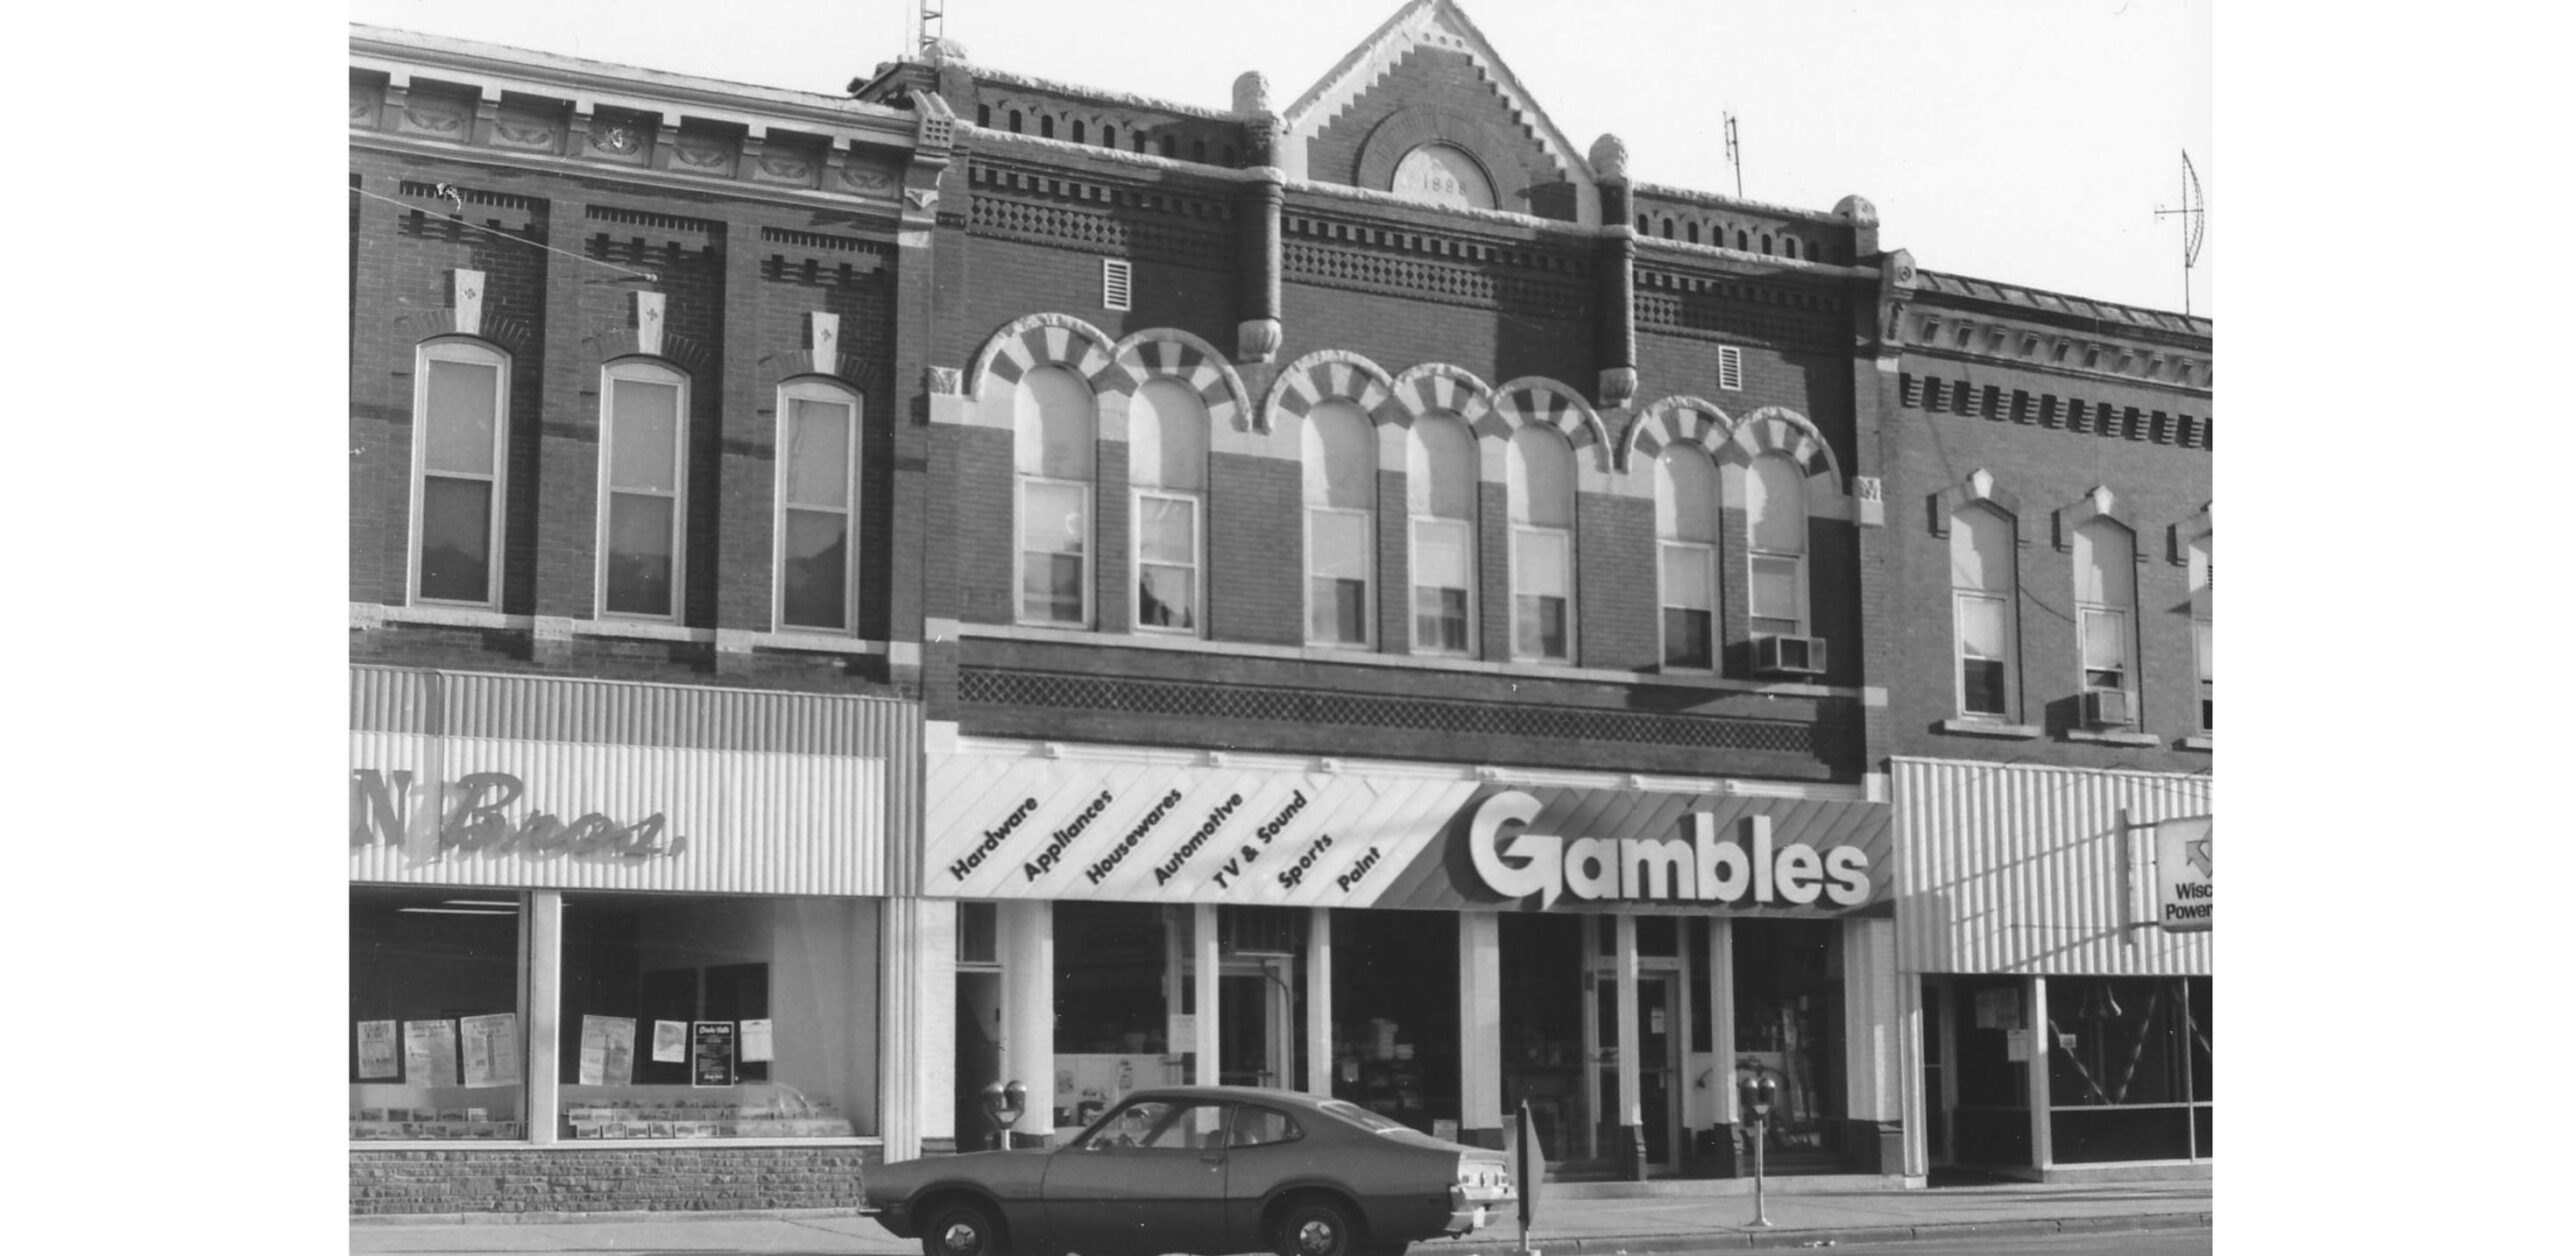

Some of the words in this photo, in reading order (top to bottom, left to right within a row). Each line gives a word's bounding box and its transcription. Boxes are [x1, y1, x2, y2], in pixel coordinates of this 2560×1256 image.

[440, 772, 687, 858] Bros.
[949, 796, 1039, 882] Hardware
[1022, 788, 1113, 882] Appliances
[1086, 787, 1182, 886] Housewares
[1153, 791, 1243, 887] Automotive
[1213, 858, 1242, 891] TV
[1240, 845, 1259, 864] &
[1256, 789, 1308, 845] Sound
[1470, 790, 1871, 911] Gambles
[1278, 832, 1333, 890] Sports
[1336, 845, 1382, 894] Paint
[2175, 882, 2213, 899] Wisc
